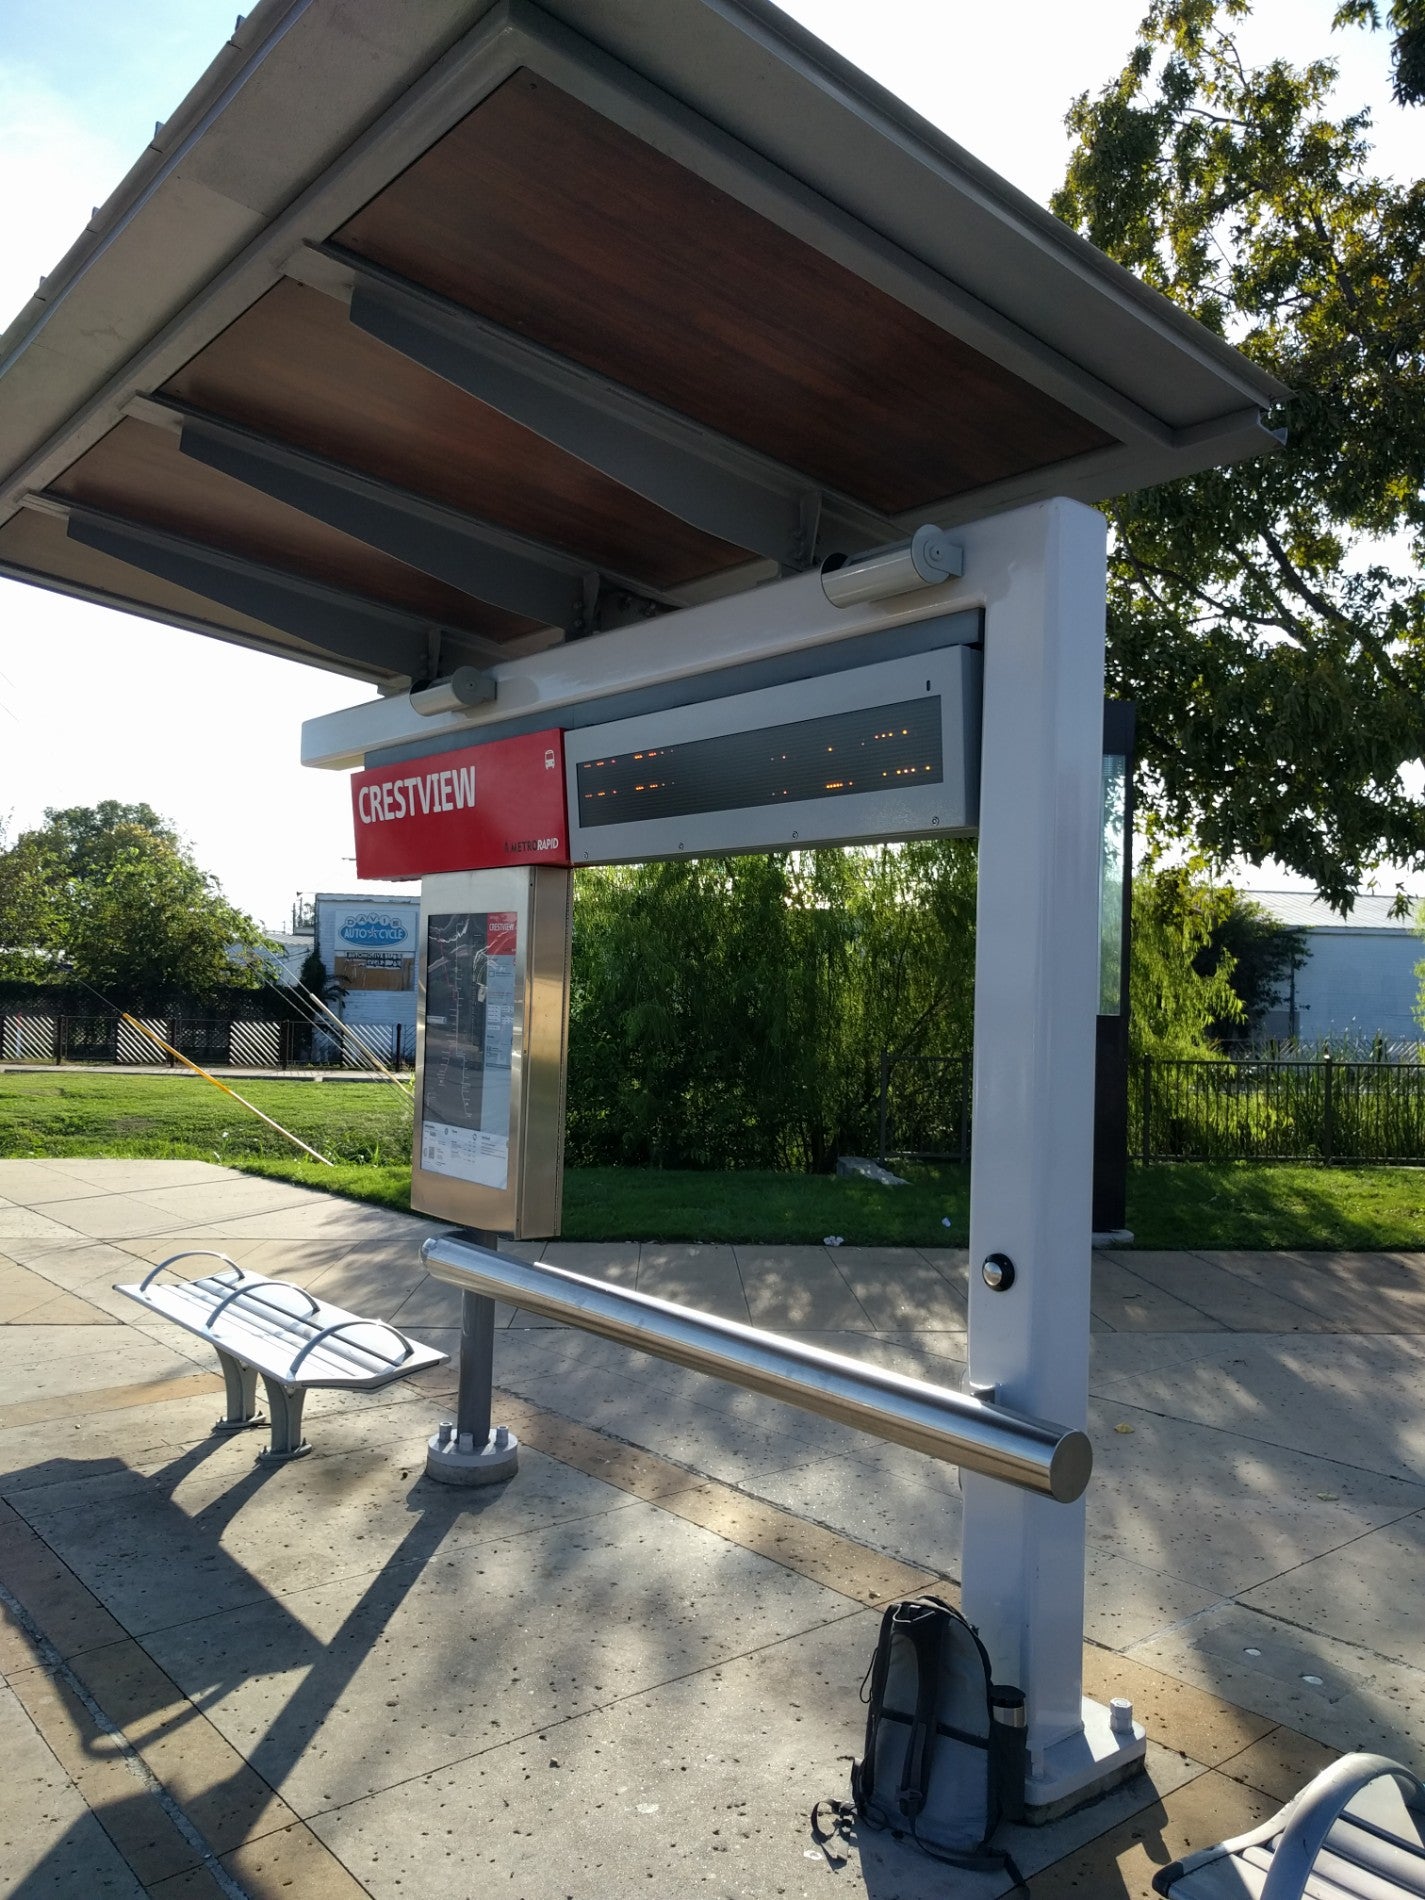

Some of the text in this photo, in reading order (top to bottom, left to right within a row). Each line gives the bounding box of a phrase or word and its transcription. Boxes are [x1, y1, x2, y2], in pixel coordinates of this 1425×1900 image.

[358, 765, 476, 824] CRESTVIEW
[488, 923, 515, 931] CRESTVIEW
[344, 928, 404, 940] AUTO CYCLE
